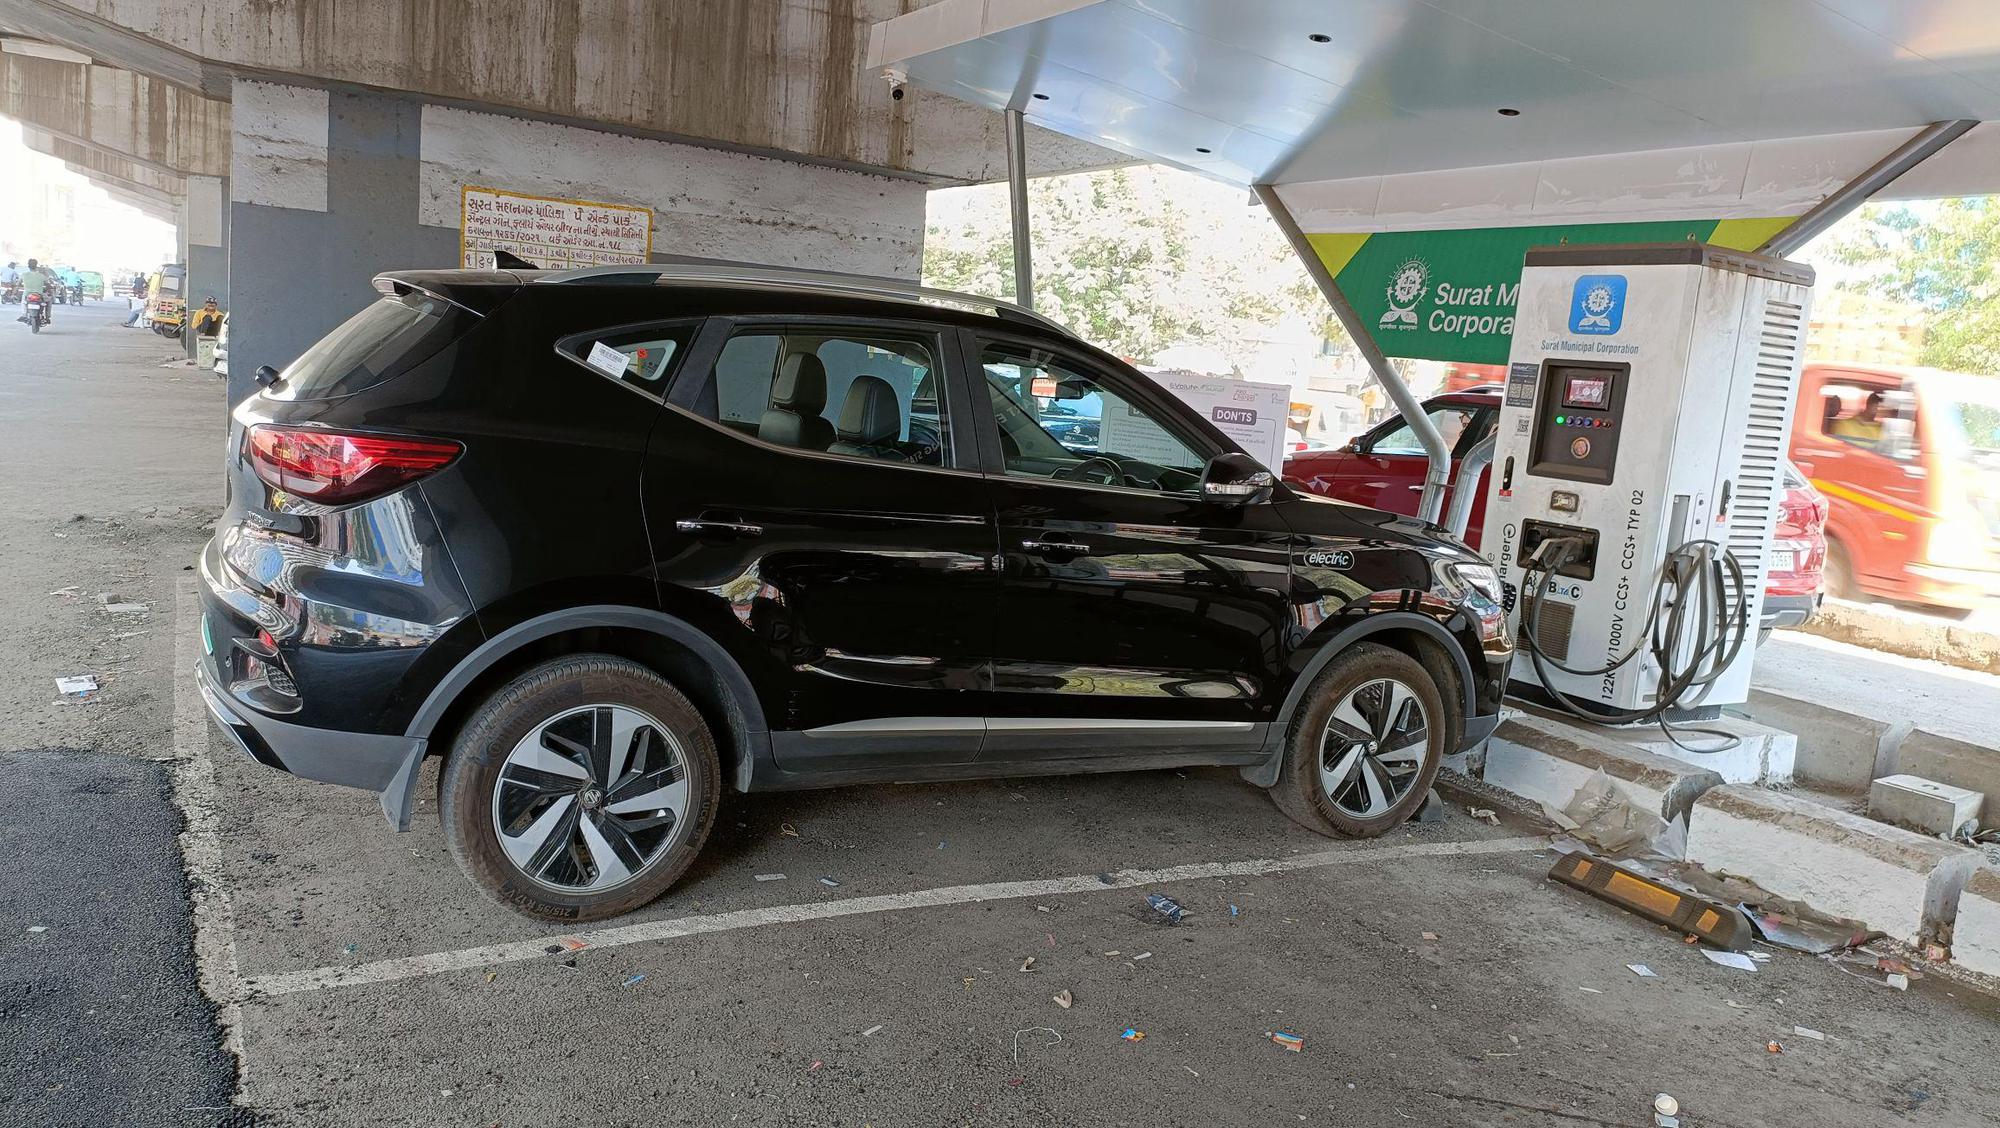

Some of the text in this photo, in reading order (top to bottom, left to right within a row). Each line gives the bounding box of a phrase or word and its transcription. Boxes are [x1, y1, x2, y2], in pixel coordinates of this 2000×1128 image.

[468, 198, 492, 213] સુરત
[495, 201, 534, 216] મહાનગર
[1434, 282, 1493, 306] Surat
[1541, 339, 1639, 355] Surat Municipal Corporation
[1216, 409, 1253, 422] DON'TS
[1631, 489, 1645, 506] 02
[1627, 508, 1642, 531] TYP
[1309, 551, 1349, 565] electric
[1621, 534, 1636, 570] CCS+
[1549, 581, 1557, 593] B
[1570, 586, 1580, 599] C
[1615, 575, 1629, 611] CCS+
